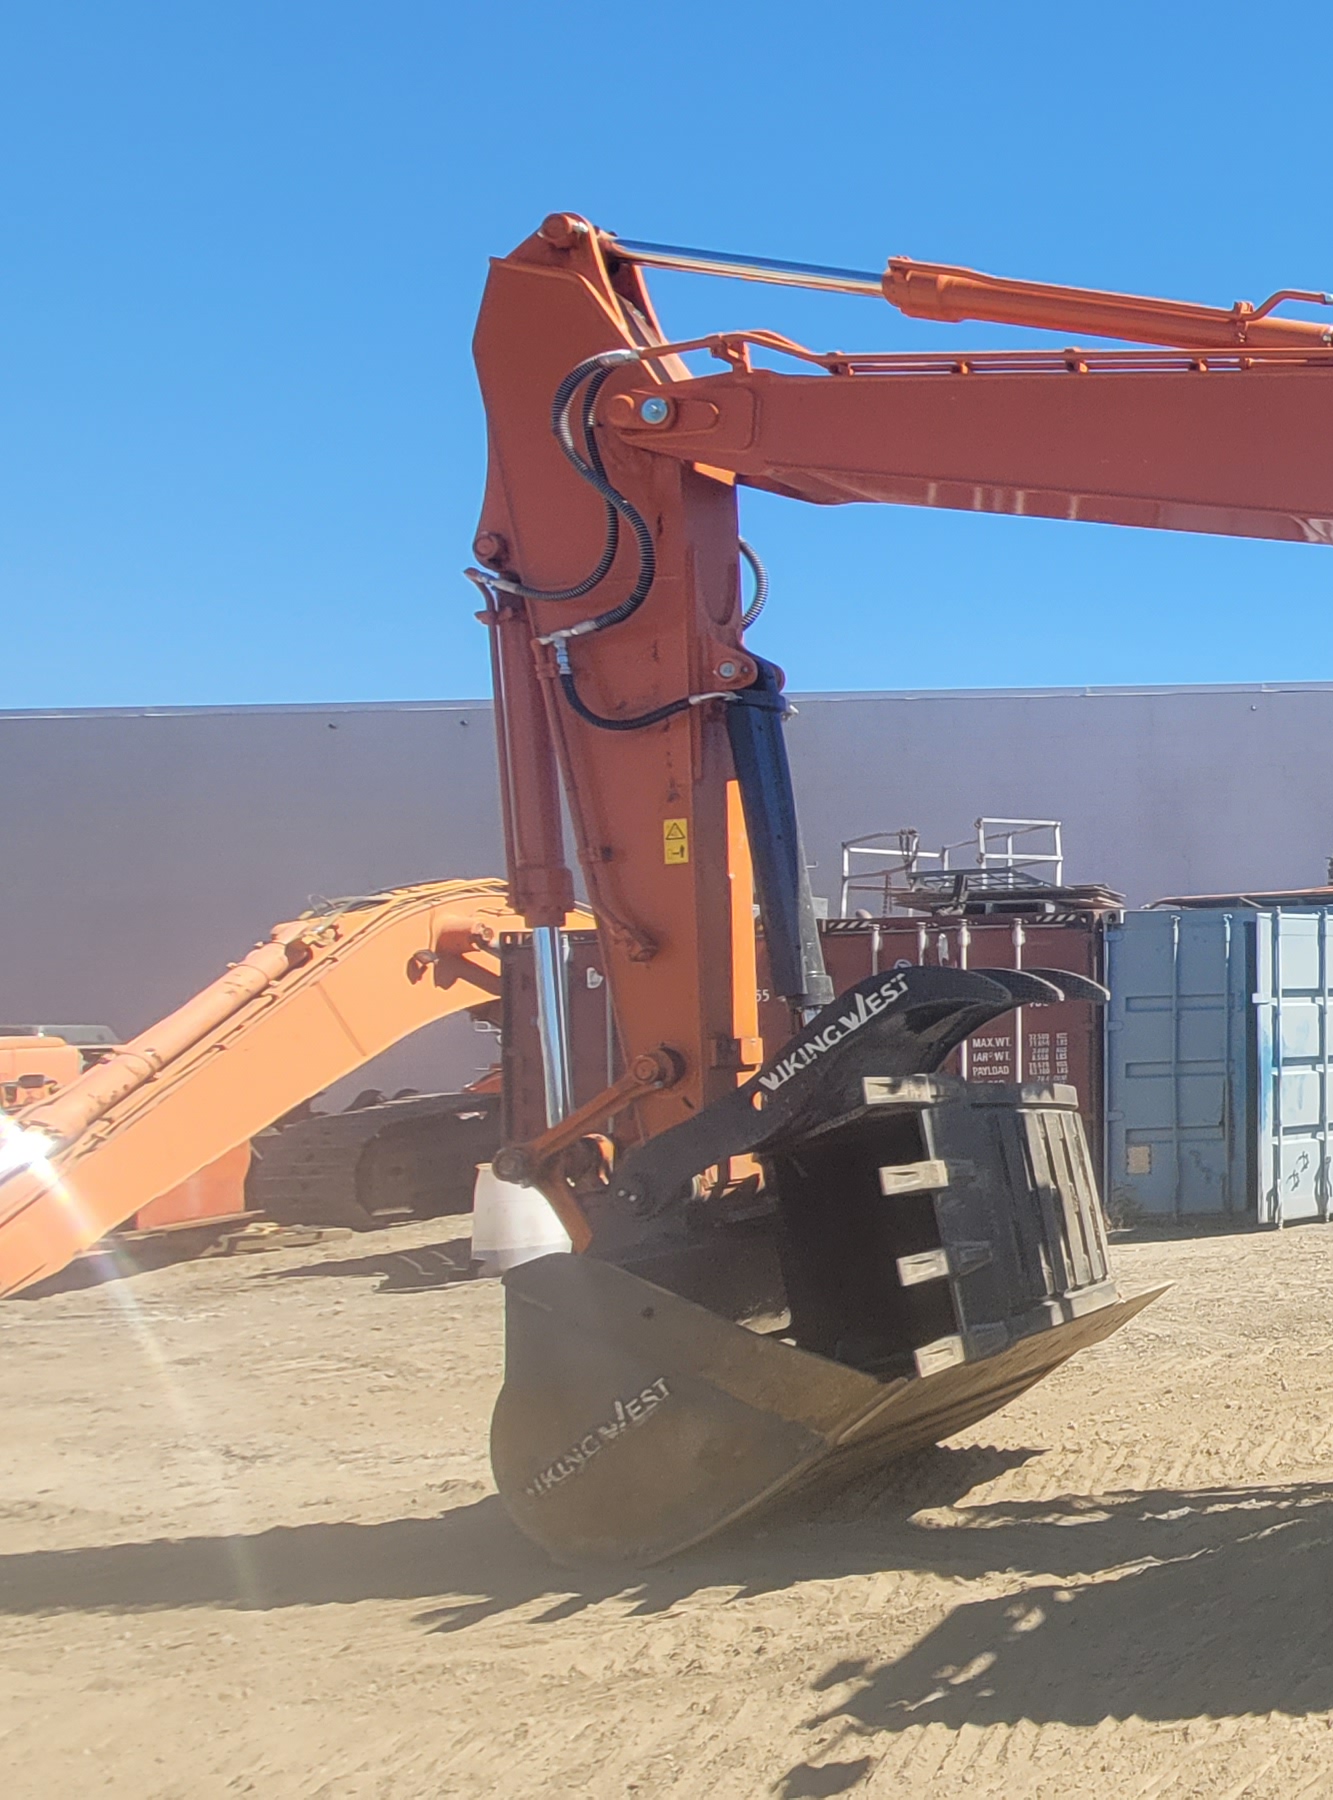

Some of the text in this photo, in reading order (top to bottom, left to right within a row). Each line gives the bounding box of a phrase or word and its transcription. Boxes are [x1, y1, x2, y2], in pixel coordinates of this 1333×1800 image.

[758, 972, 909, 1091] VIKING WEST
[972, 1064, 1010, 1077] PAYLOAD
